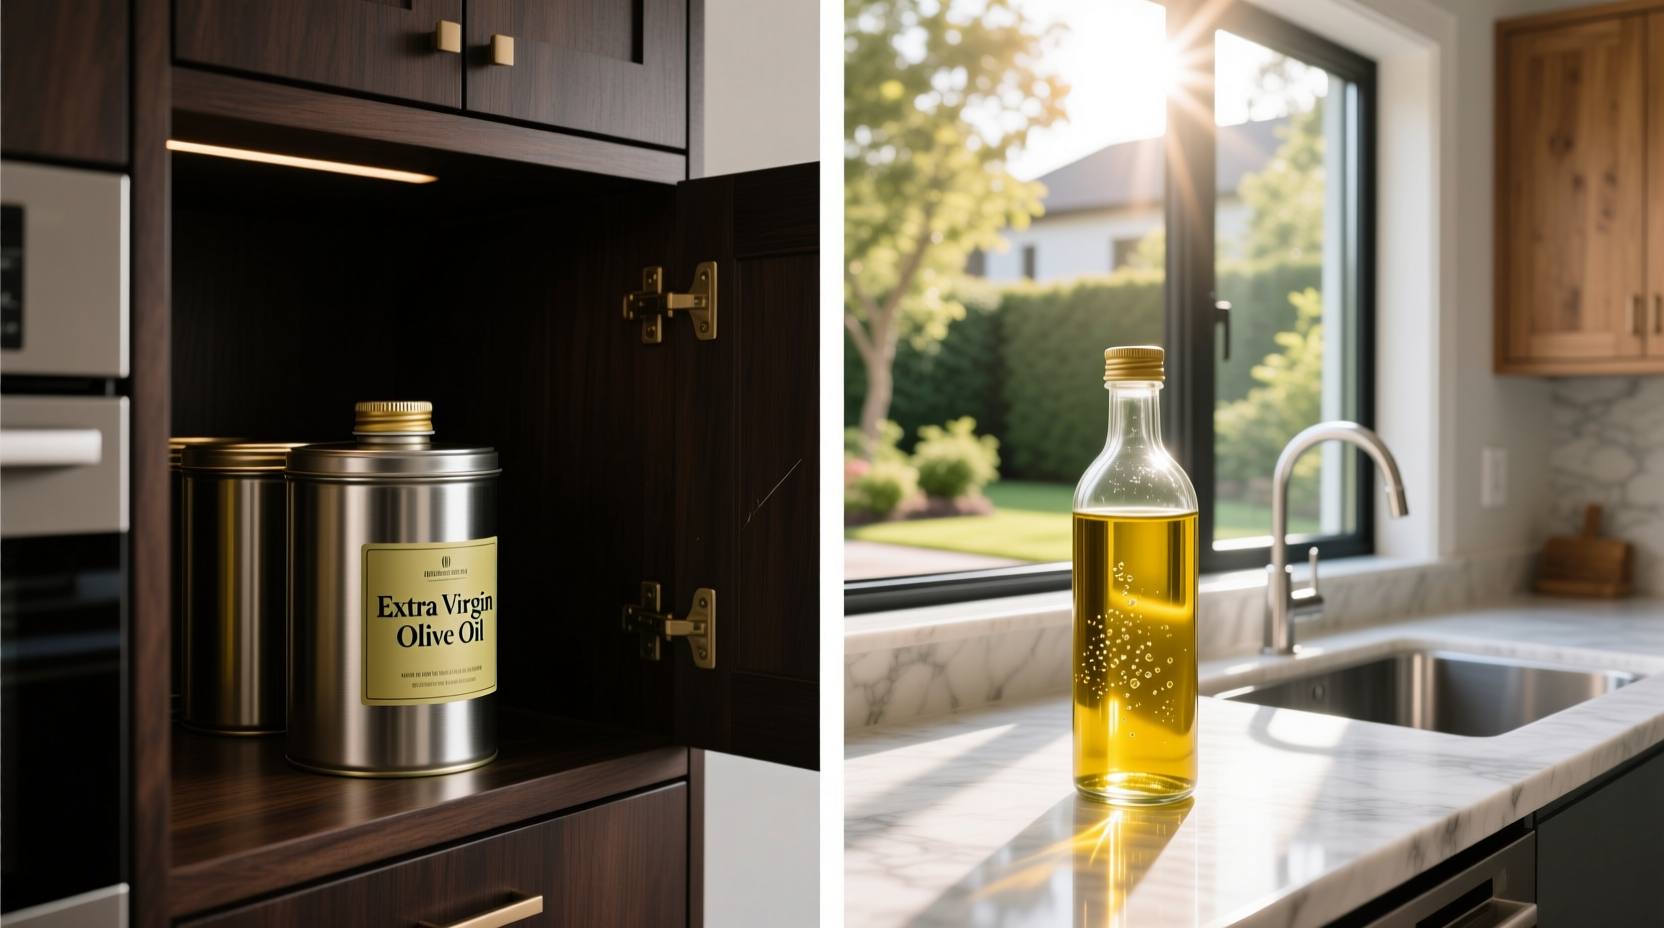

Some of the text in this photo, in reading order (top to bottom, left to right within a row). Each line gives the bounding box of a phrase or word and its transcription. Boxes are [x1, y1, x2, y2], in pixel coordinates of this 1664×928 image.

[377, 591, 493, 619] Extra Virgin
[397, 618, 484, 648] Olive Oil
